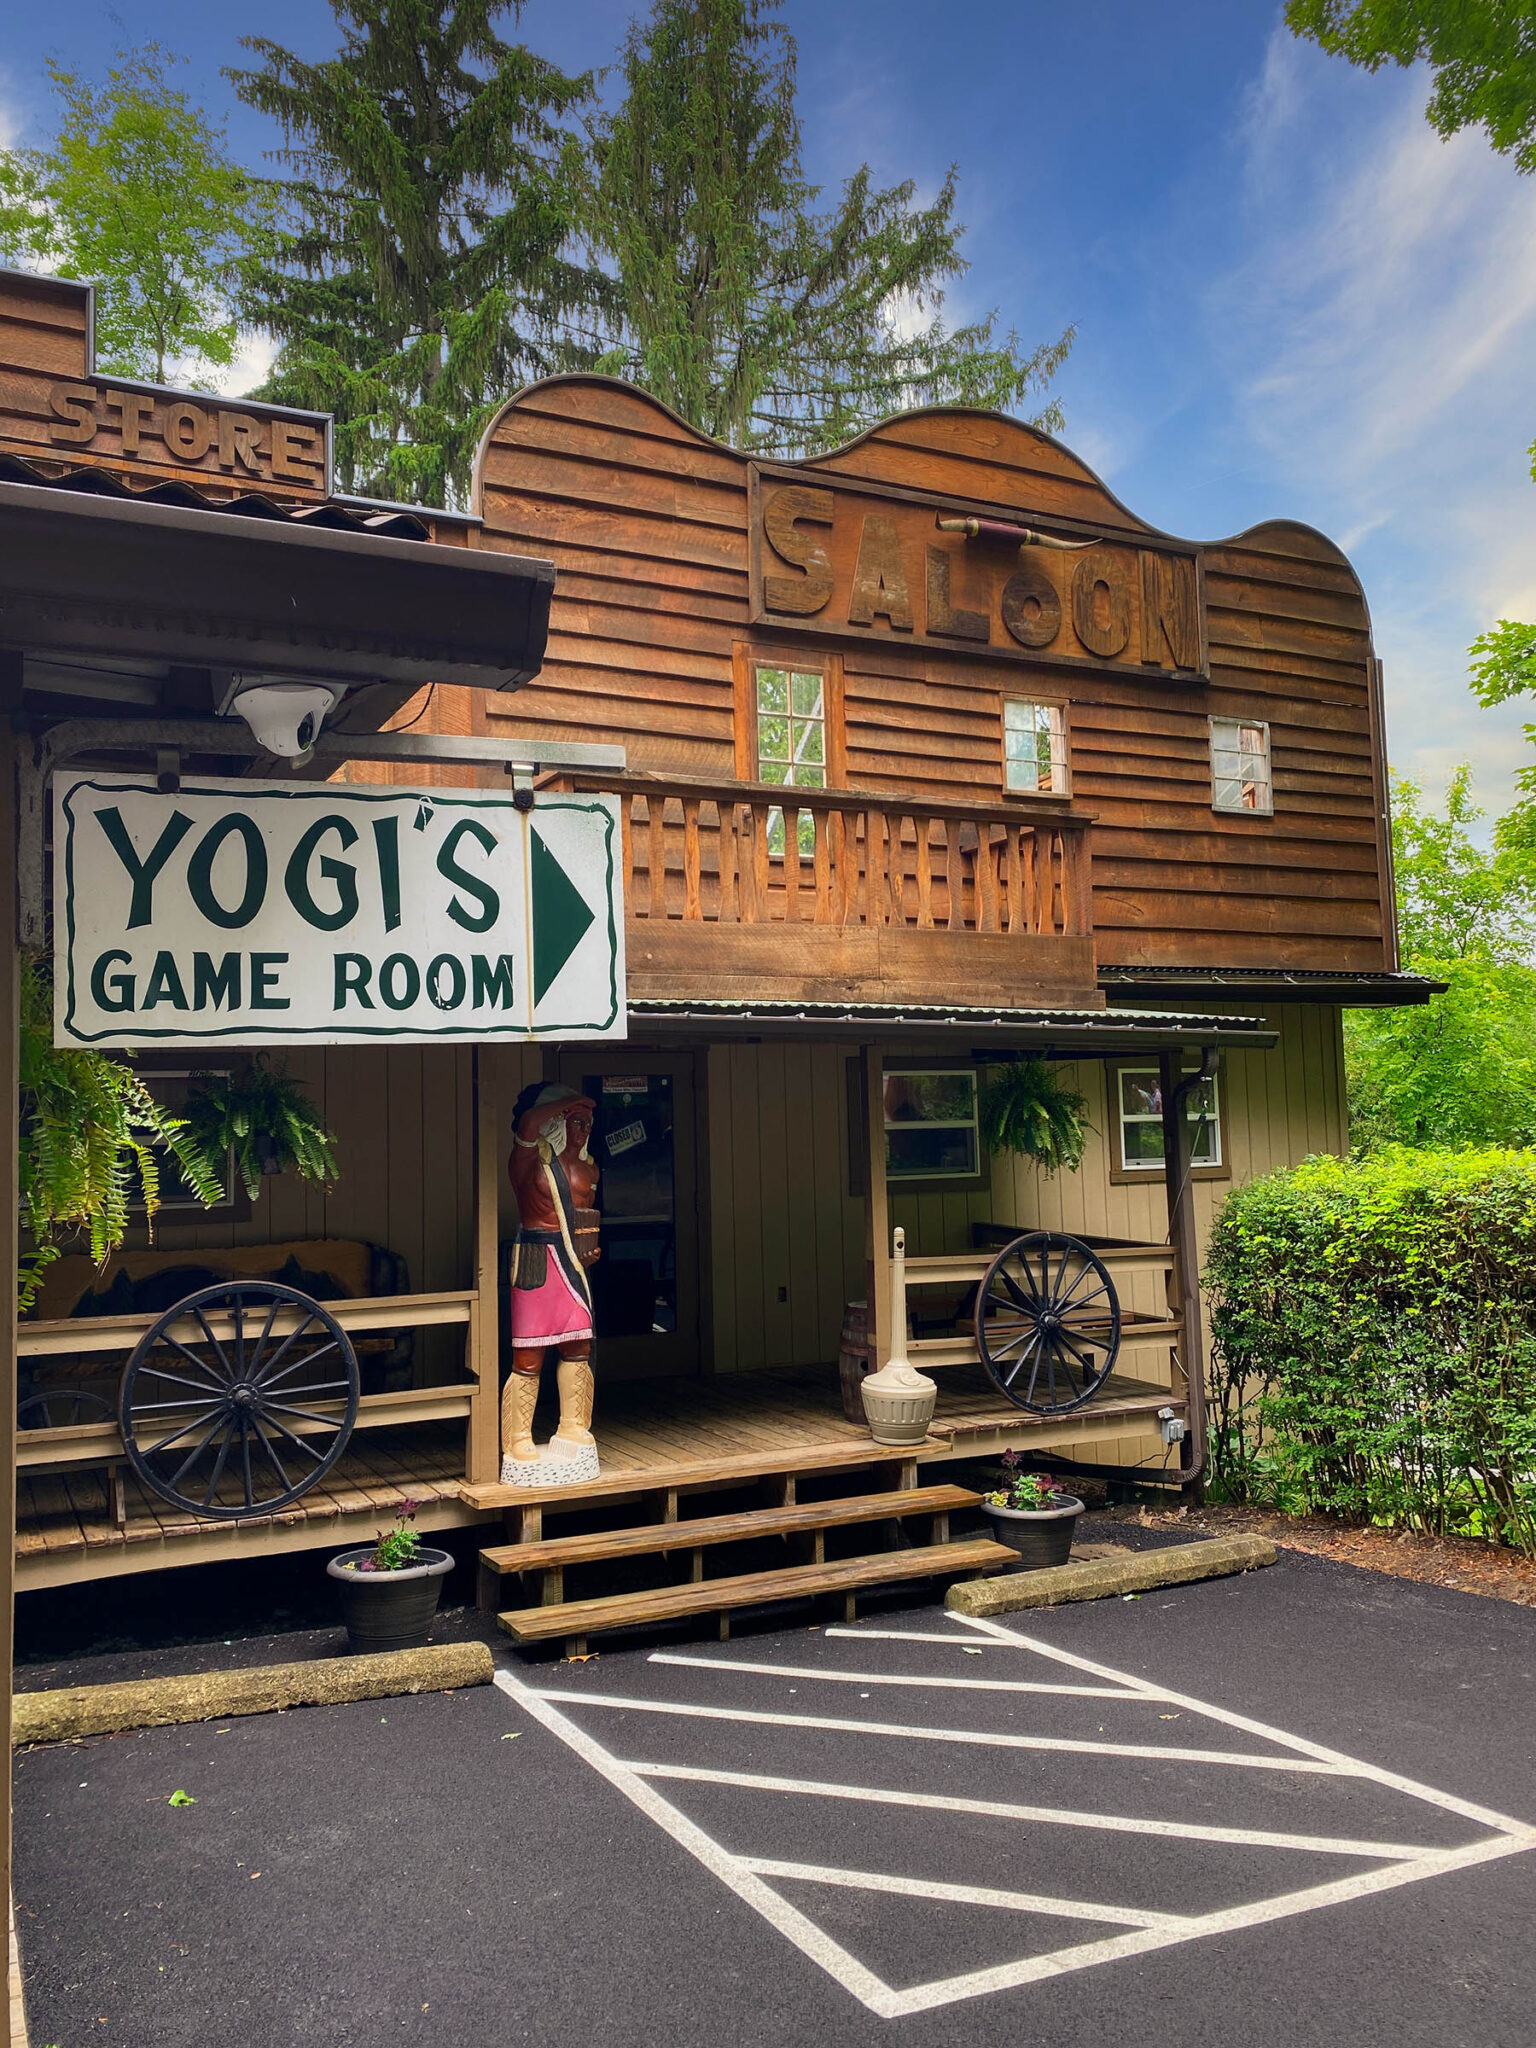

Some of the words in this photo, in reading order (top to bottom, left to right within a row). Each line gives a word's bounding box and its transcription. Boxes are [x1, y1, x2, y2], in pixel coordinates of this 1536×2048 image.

[49, 385, 317, 484] STORE
[764, 486, 1198, 669] SALOON
[93, 803, 501, 934] YOGI'S
[90, 950, 291, 1013] GAME
[333, 952, 514, 1012] ROOM
[608, 1127, 631, 1147] CLOSED
